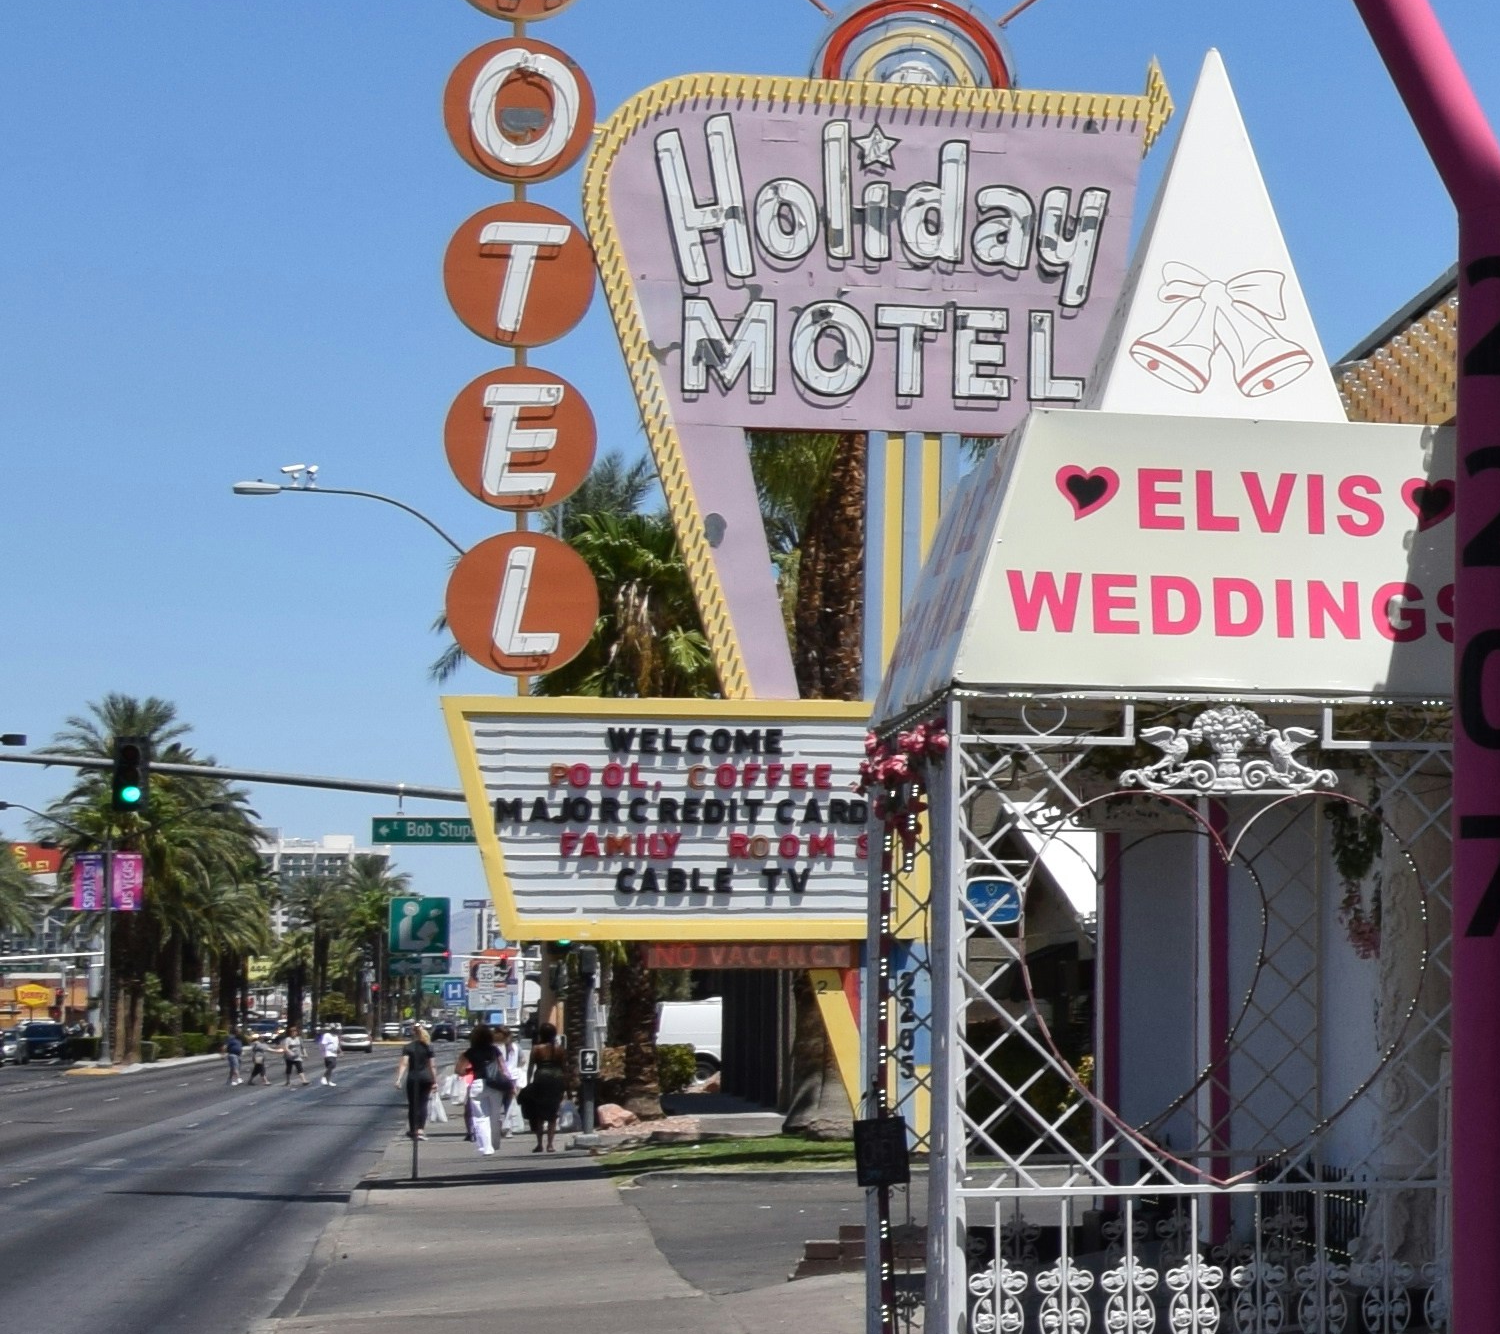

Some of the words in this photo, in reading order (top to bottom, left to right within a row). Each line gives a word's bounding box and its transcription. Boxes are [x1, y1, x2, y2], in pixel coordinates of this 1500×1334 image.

[654, 112, 1110, 309] Holiday
[678, 297, 1085, 407] MOTEL
[1136, 467, 1385, 537] ELVIS
[607, 727, 783, 755] WELCOME
[549, 763, 662, 792] POOL,
[689, 763, 832, 789] COFFEE
[406, 821, 433, 837] Bob
[560, 832, 681, 860] FAMILY
[615, 867, 733, 894] CABLE
[761, 867, 811, 894] TV
[655, 943, 697, 966] NO
[709, 945, 848, 967] VACANCY
